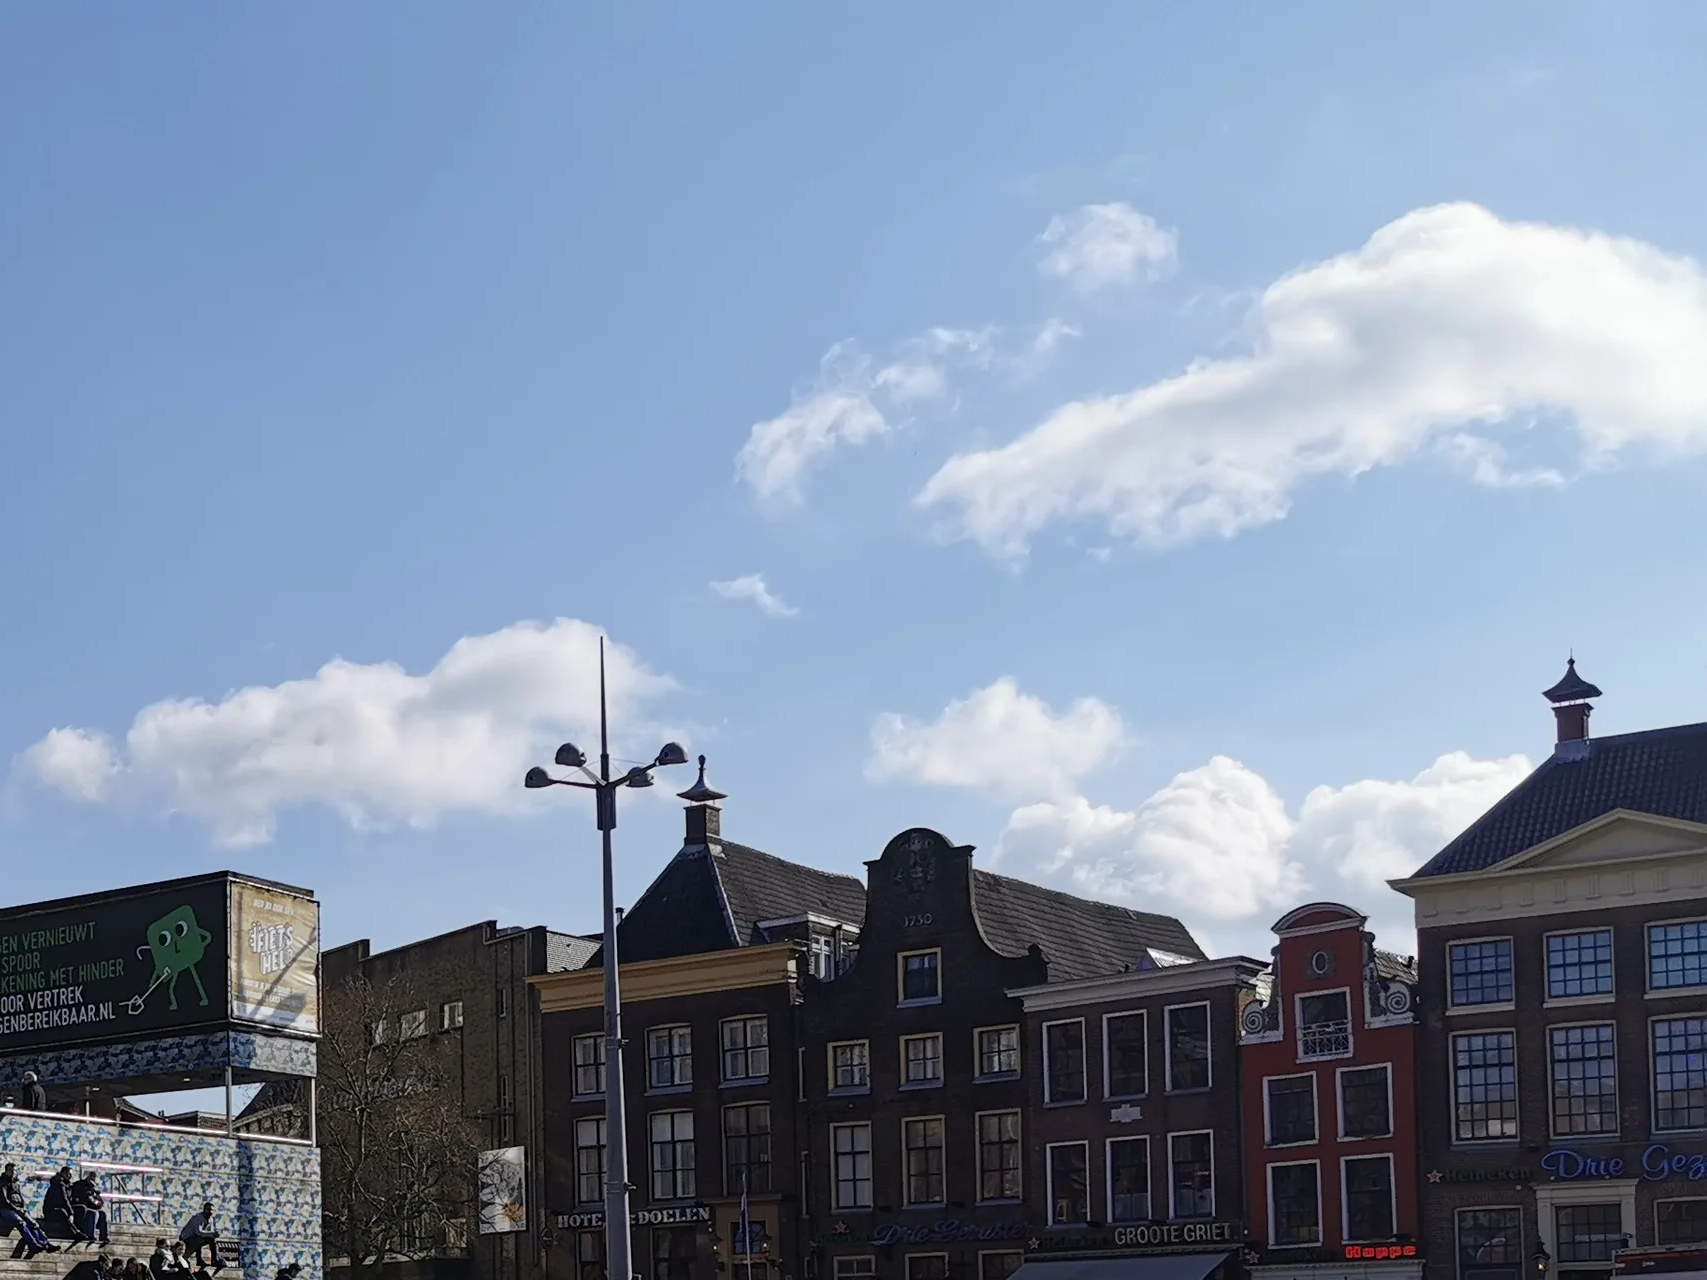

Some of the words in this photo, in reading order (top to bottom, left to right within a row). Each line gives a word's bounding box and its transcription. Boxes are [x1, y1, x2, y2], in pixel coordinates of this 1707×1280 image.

[21, 922, 96, 951] VERNIEUWT
[1, 952, 41, 974] SPOOR
[49, 966, 75, 988] MET
[78, 958, 125, 983] HINDER
[27, 985, 84, 1006] VERTREK
[1444, 1165, 1531, 1182] Heineken
[1540, 1149, 1624, 1179] Drie
[557, 1212, 606, 1228] HOTE
[638, 1206, 710, 1225] DOELEN
[1114, 1225, 1180, 1246] GROOTE
[1183, 1222, 1231, 1242] GRIET
